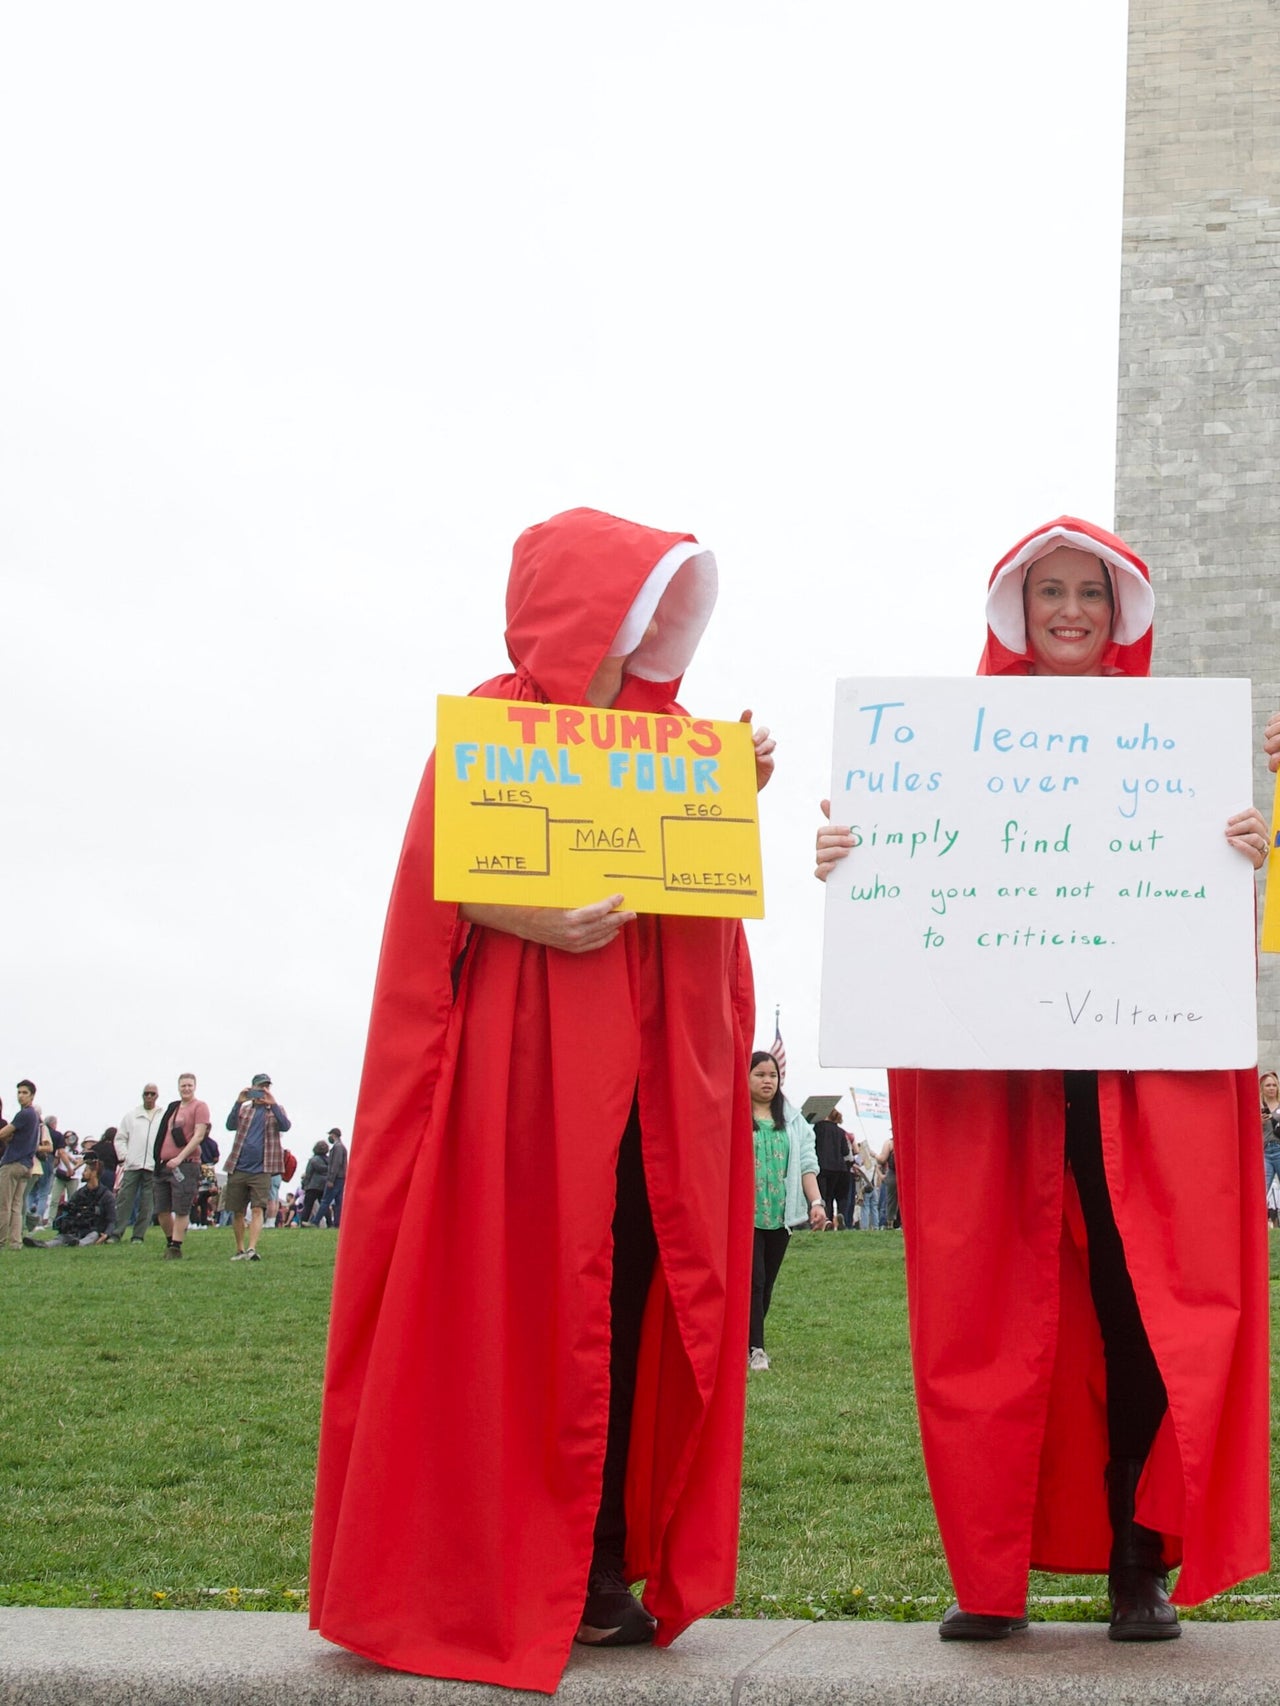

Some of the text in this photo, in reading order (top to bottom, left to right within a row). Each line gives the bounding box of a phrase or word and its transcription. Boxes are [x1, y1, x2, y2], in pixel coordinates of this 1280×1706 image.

[507, 706, 722, 757] TRUMP'S
[860, 702, 1176, 753] To learn who
[454, 743, 721, 794] FINAL FOUR
[482, 789, 533, 803] LIES
[845, 761, 1196, 818] rules over you,
[684, 804, 722, 817] EGO
[575, 827, 641, 849] MAGA
[849, 819, 1164, 858] simply find out
[476, 856, 527, 870] HATE
[670, 873, 752, 886] ABLEISM
[851, 874, 1206, 914] who you are not allowed
[923, 926, 1116, 949] to criticise.
